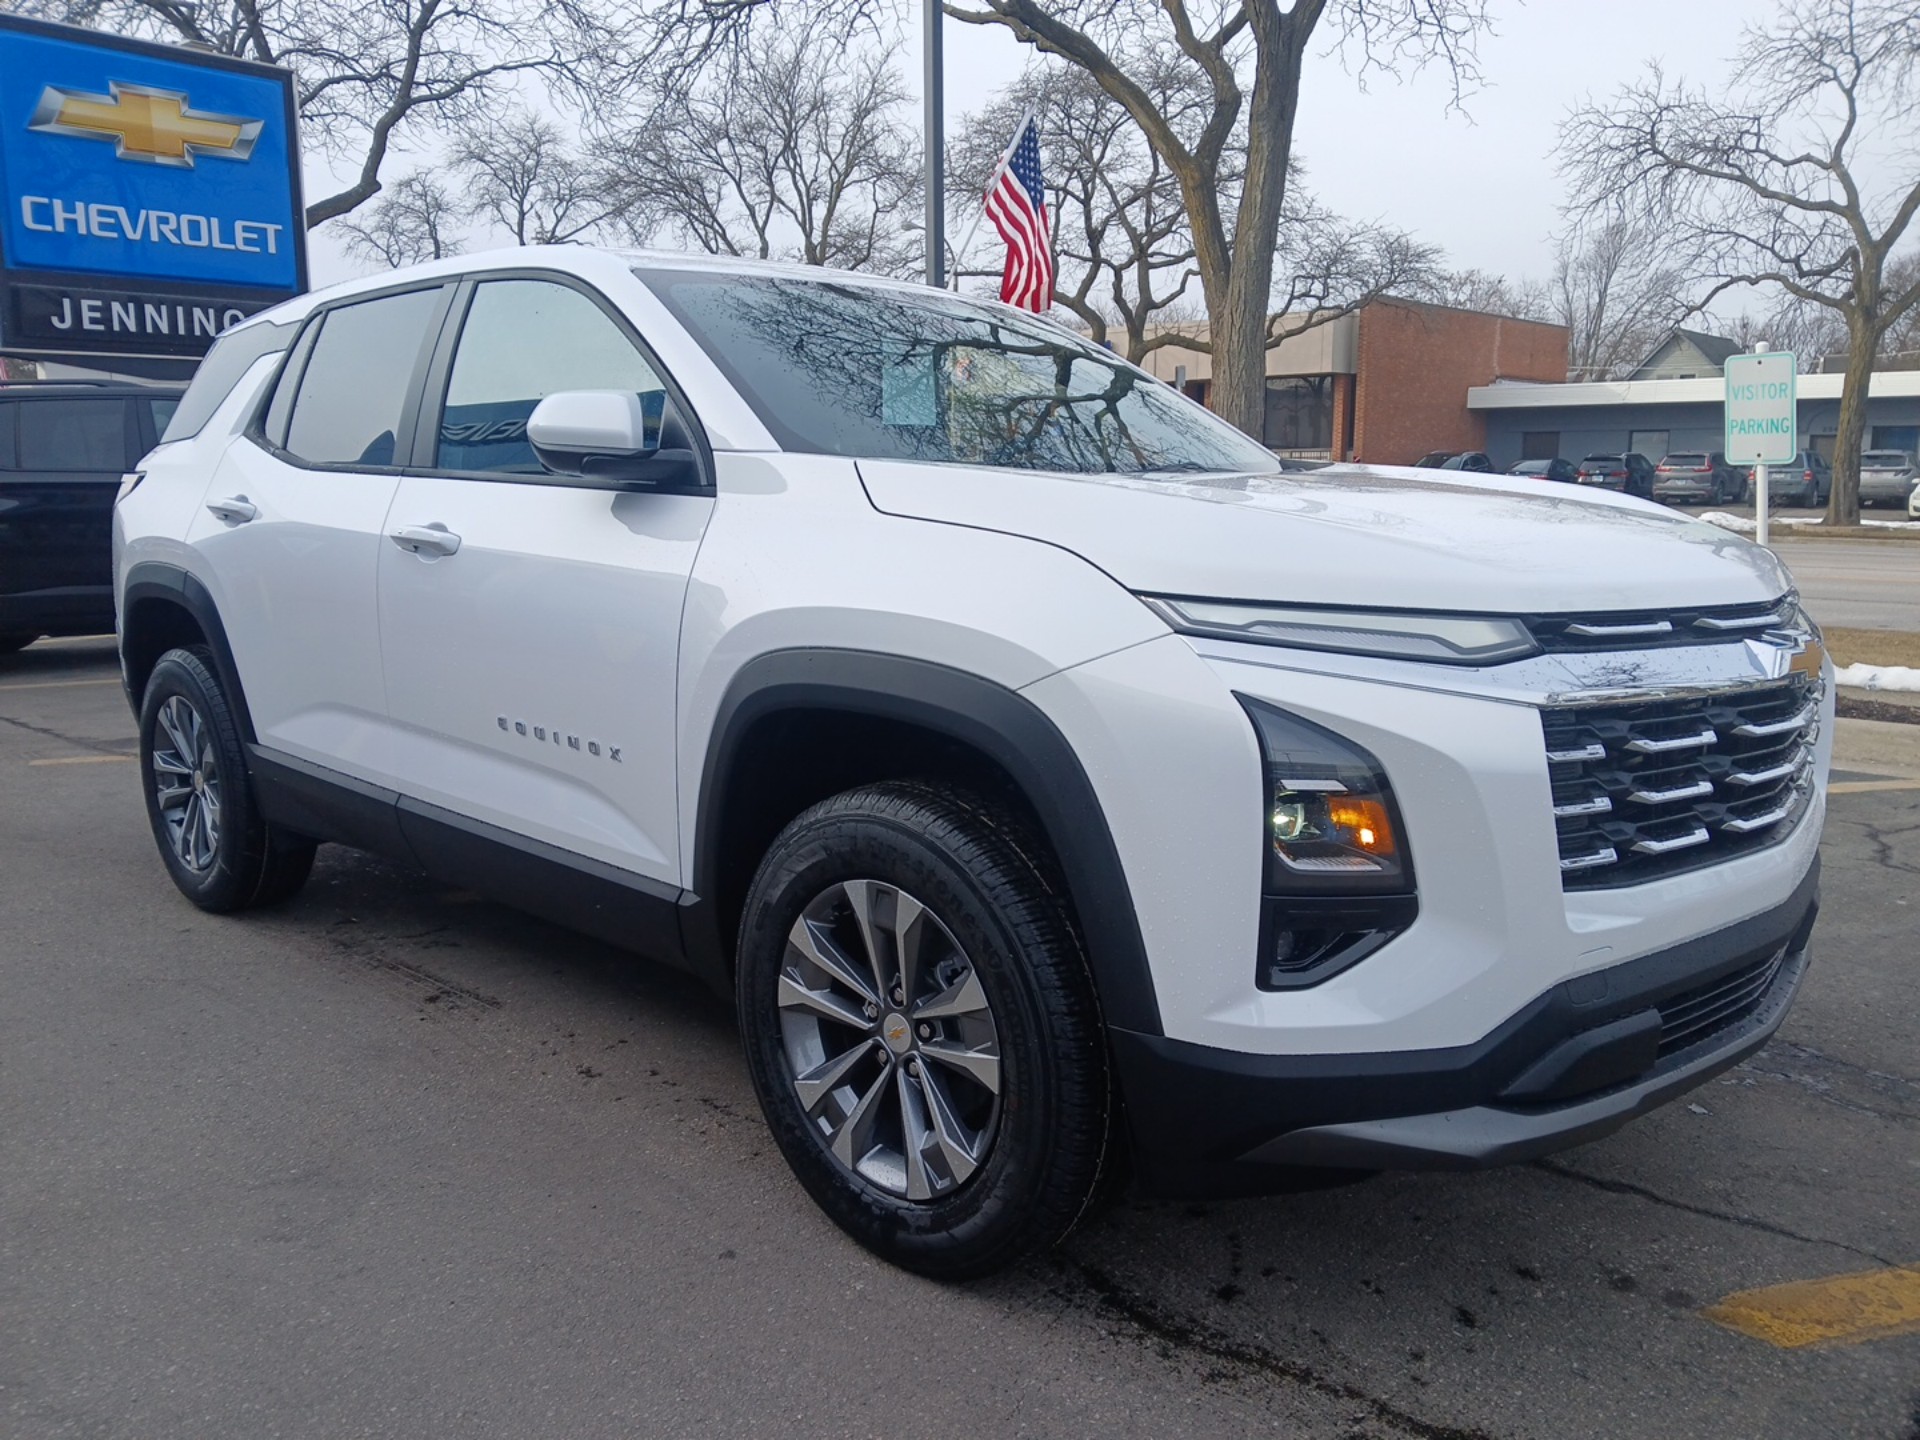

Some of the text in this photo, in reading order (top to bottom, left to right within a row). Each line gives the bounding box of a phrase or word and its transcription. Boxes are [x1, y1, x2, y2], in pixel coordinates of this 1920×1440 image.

[21, 195, 283, 254] CHEVROLET
[1731, 382, 1788, 400] VISITOR
[1730, 417, 1790, 435] PARKING
[497, 716, 622, 763] EQUINOX
